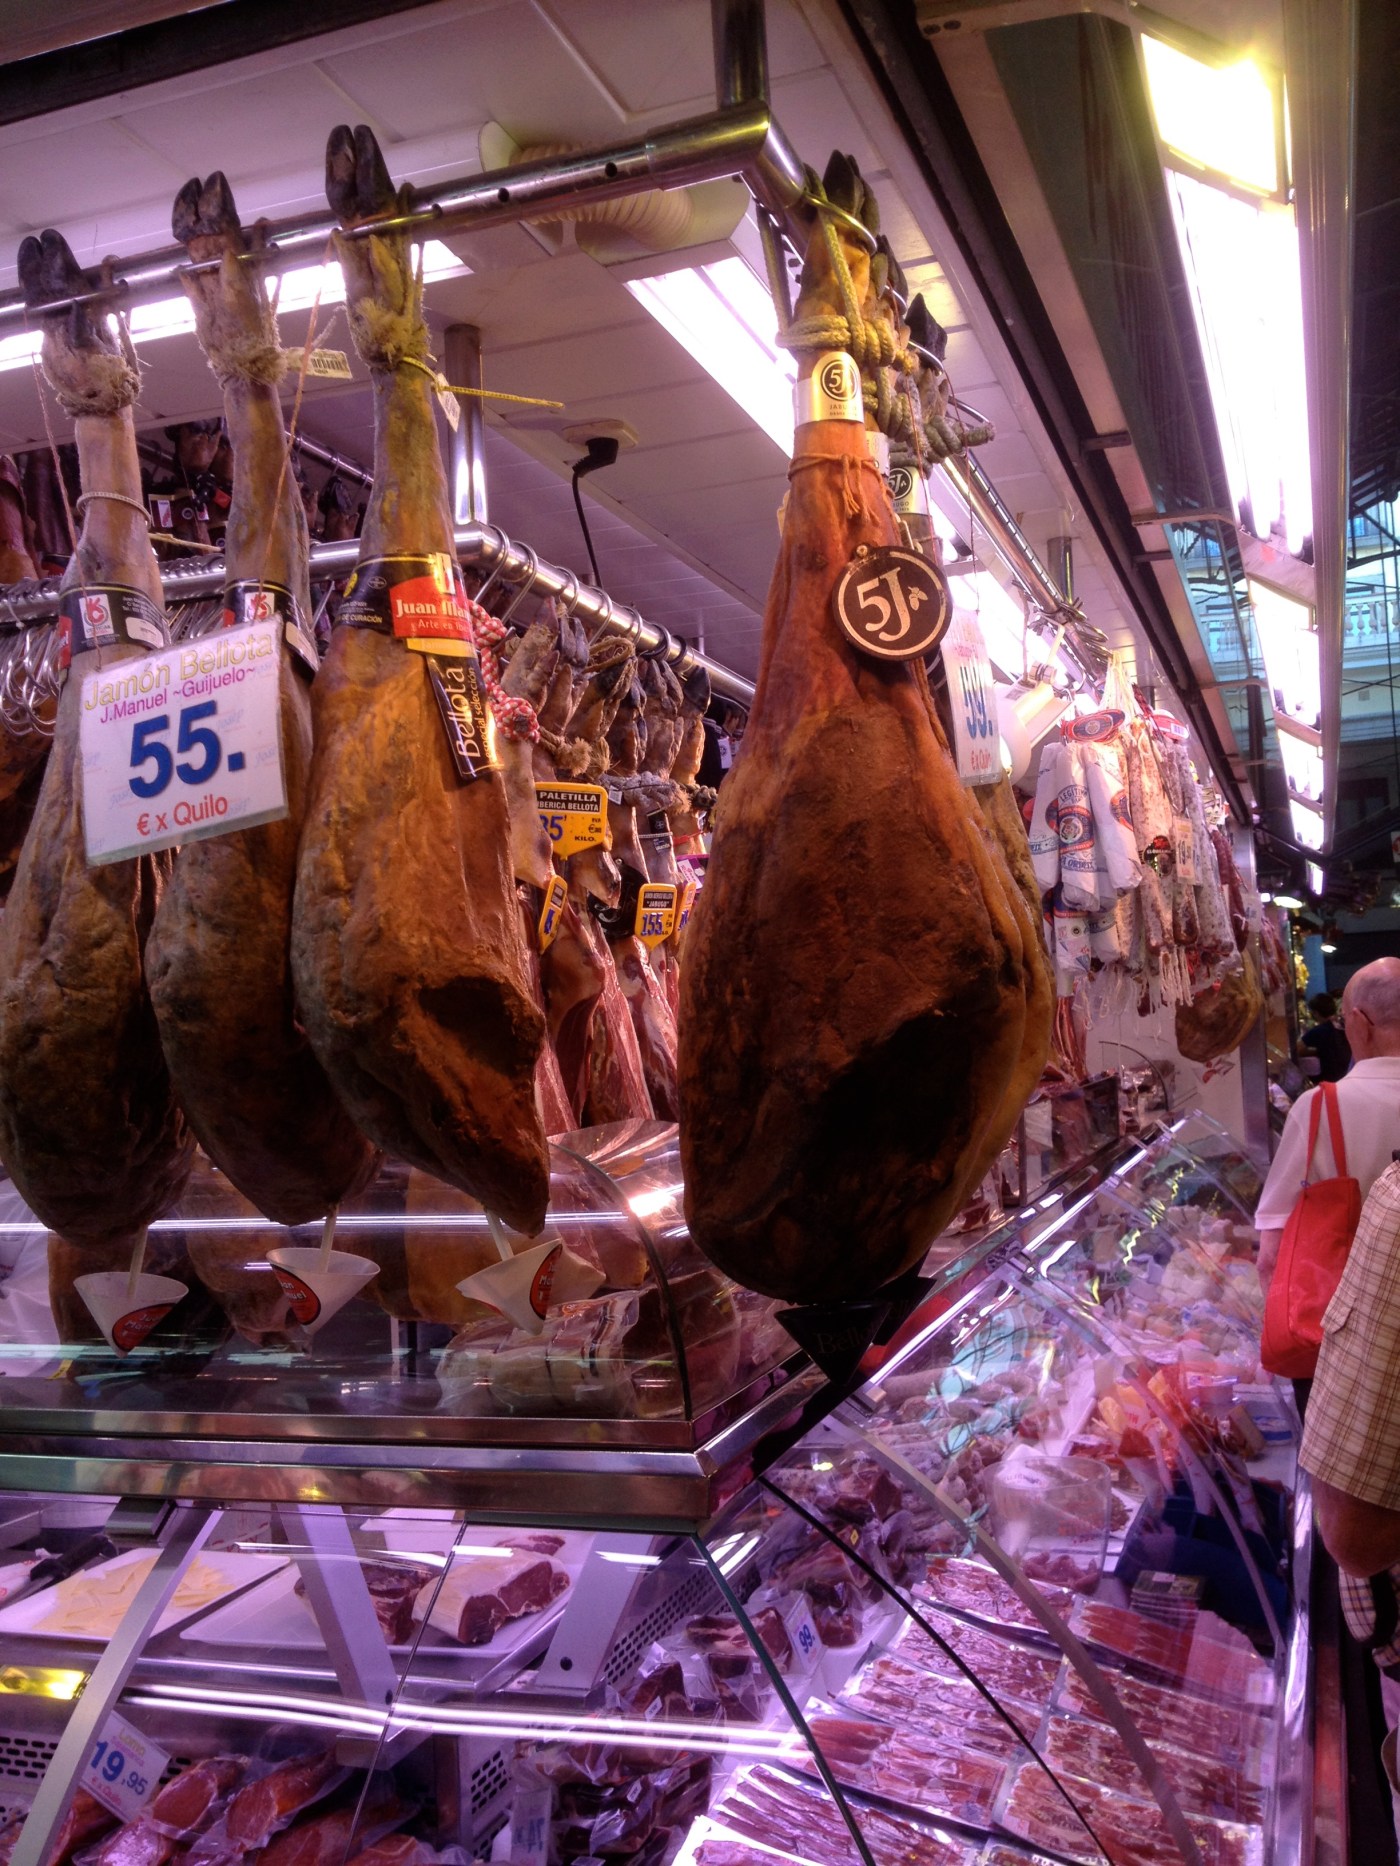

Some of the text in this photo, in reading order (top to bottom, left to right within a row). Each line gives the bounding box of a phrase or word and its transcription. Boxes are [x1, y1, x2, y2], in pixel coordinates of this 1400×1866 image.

[396, 599, 437, 618] Juan
[857, 567, 911, 641] 5J
[418, 619, 440, 629] Arte
[84, 634, 273, 711] Jamón Bellota
[467, 667, 484, 715] selección
[100, 689, 168, 723] J.Manuel
[445, 667, 481, 757] Bellota
[137, 812, 151, 836] €
[155, 812, 169, 832] x
[173, 794, 228, 826] Quilo
[540, 791, 597, 802] PALETILLA
[567, 802, 599, 812] BELLOTA
